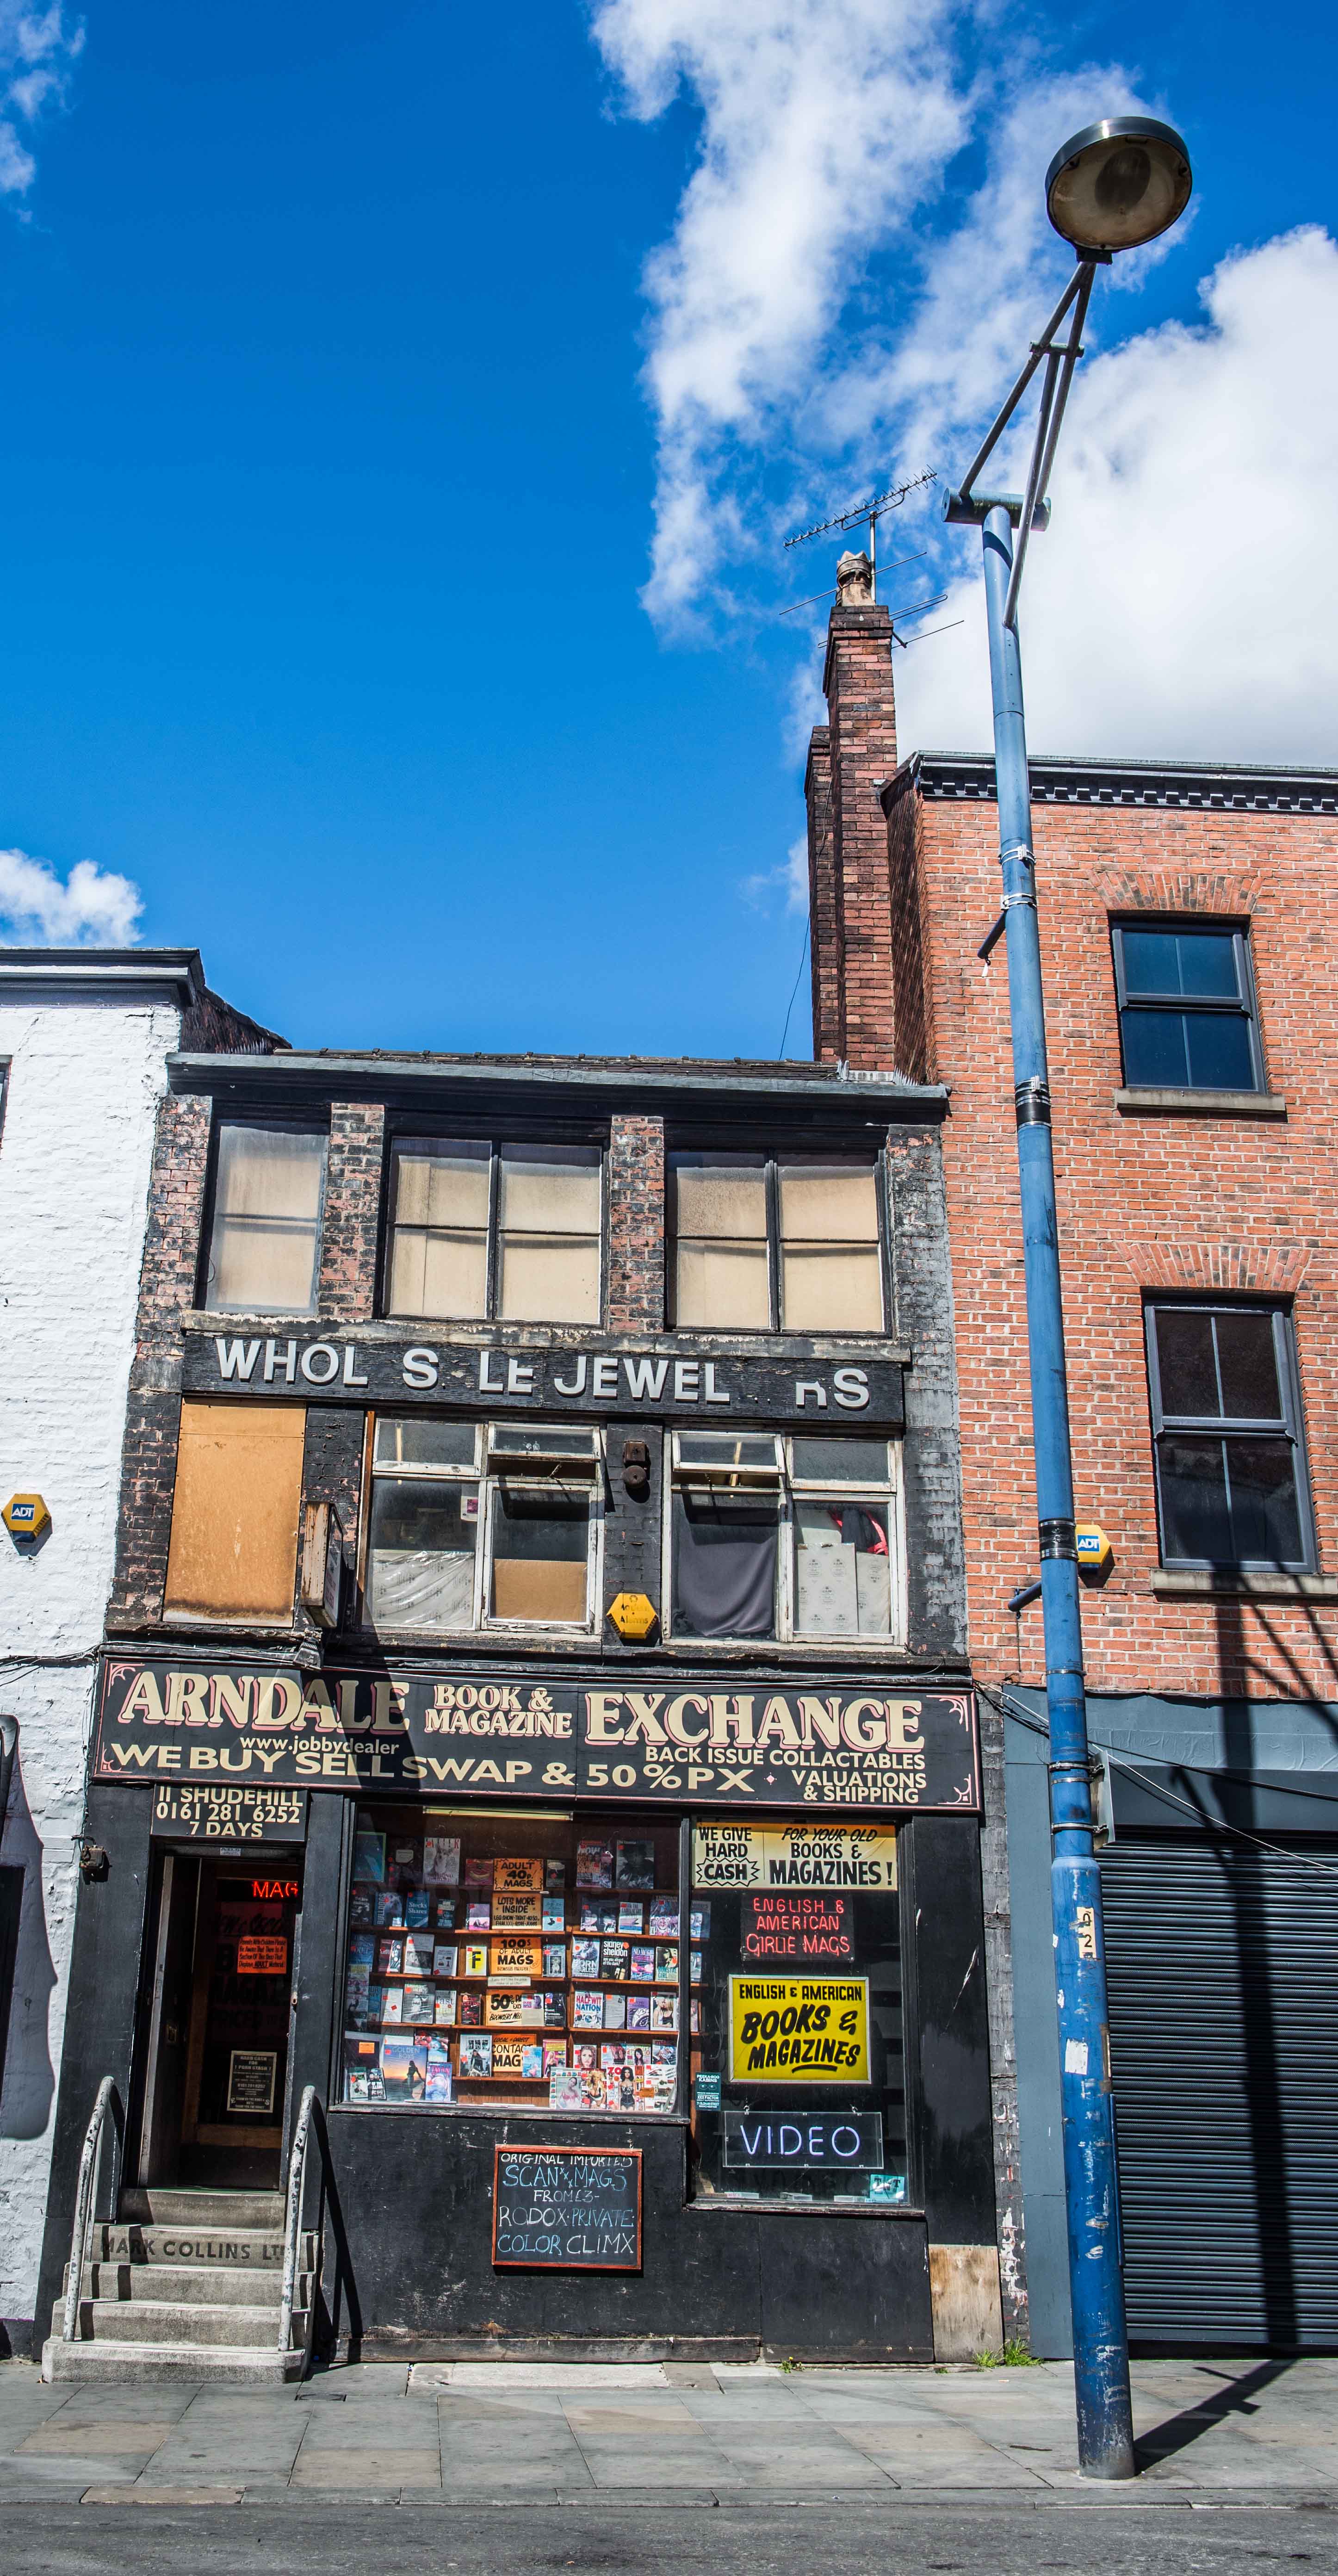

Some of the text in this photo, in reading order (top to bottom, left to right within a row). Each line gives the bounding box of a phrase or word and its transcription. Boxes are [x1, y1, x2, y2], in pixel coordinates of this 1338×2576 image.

[12, 1507, 35, 1517] ADT
[1078, 1538, 1099, 1549] ADT
[118, 1671, 925, 1752] ARNDALE BOOK & EXCHANGE
[424, 1709, 573, 1738] MAGAZINE
[241, 1736, 399, 1755] www.jobbydealer
[112, 1744, 182, 1768] WE
[190, 1747, 287, 1772] BUY
[296, 1752, 394, 1777] SELL
[402, 1756, 532, 1782] SWAP
[542, 1763, 575, 1785] &
[646, 1746, 925, 1770] BACK ISSUE COLLACTABLES
[791, 1770, 926, 1789] VALUATIONS
[180, 1788, 303, 1806] SHUDEHILL
[805, 1786, 919, 1803] & SHIPPING
[157, 1804, 299, 1823] 0161 281 6252
[190, 1822, 262, 1837] 7 DAYS
[699, 1827, 877, 1842] WE GIVE FOR YOUR OLD
[706, 1843, 861, 1859] HARD BOOKS &
[704, 1864, 747, 1880] CASH
[516, 1897, 536, 1905] MORE
[753, 1898, 844, 1913] ENGLISH &
[756, 1916, 840, 1931] AMERICAN
[603, 1948, 628, 1957] sheldon
[803, 1935, 850, 1957] MAGS
[471, 1951, 481, 1969] F
[497, 1955, 533, 1965] MAGS
[576, 1995, 601, 2003] HALFWIT
[740, 1984, 862, 2001] ENGLISH & AMERICAN
[740, 2004, 858, 2044] BOOKS &
[747, 2038, 861, 2071] MAGAZINES
[740, 2125, 860, 2156] VIDEO
[501, 2153, 633, 2167] ORIGINAL IMPORTED
[502, 2164, 558, 2187] SCAN
[575, 2166, 627, 2191] MAGS
[101, 2237, 155, 2256] MARK
[163, 2241, 250, 2259] COLLINS
[497, 2234, 562, 2256] COLOR
